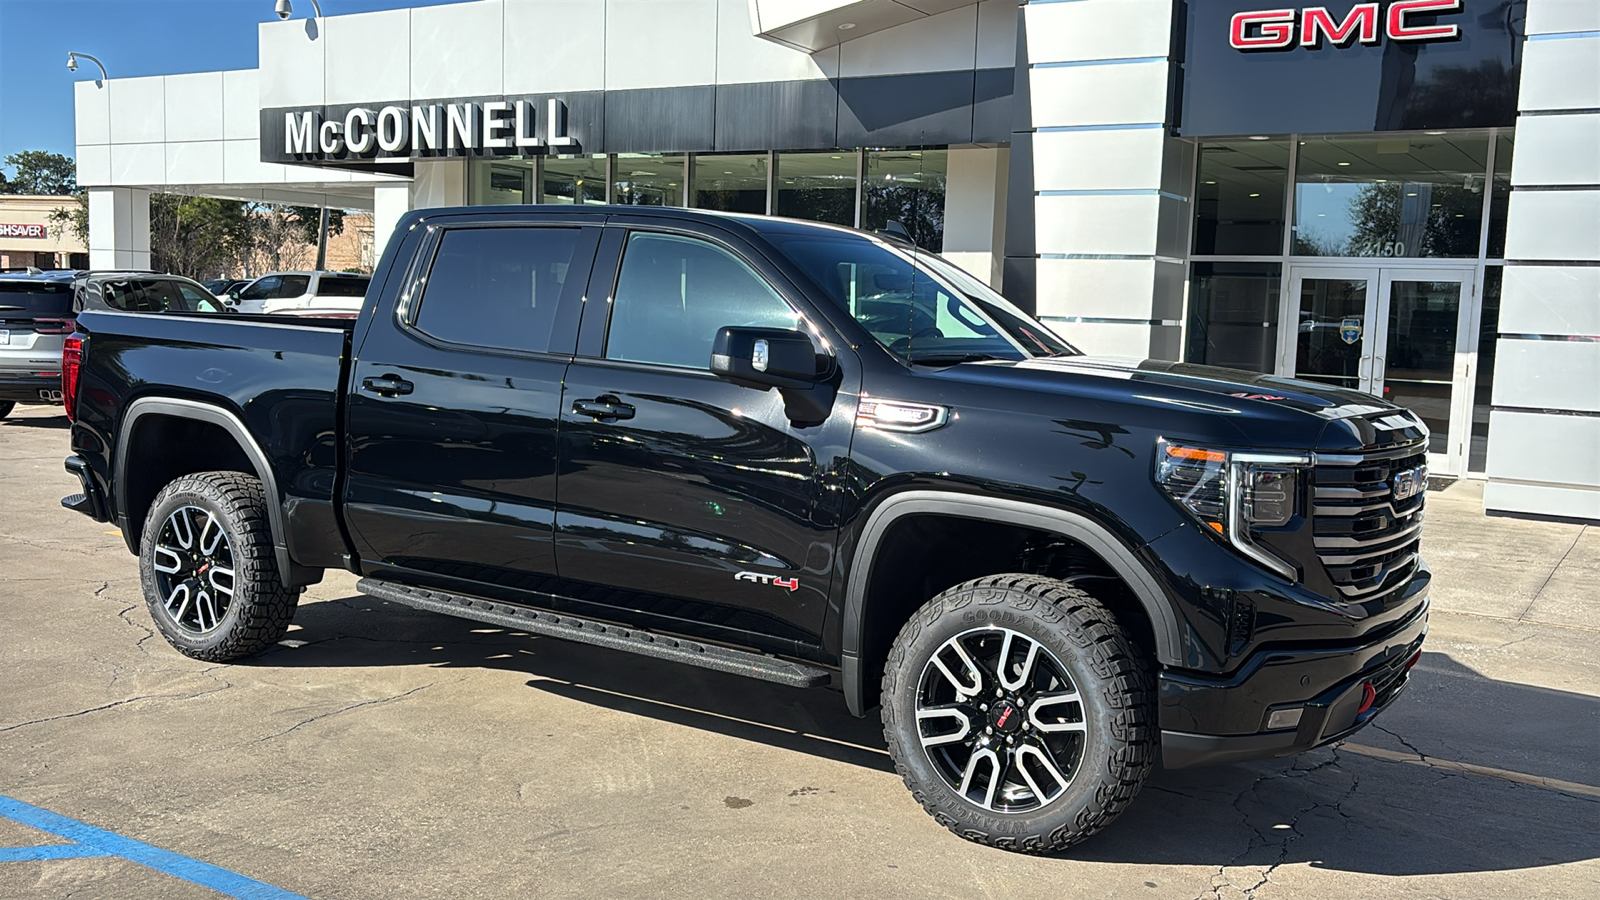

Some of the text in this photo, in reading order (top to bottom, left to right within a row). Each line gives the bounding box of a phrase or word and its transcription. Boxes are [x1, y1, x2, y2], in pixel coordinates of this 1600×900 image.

[1229, 0, 1460, 49] GMC
[285, 98, 572, 154] McCONNELL
[734, 571, 799, 592] AT4
[962, 609, 1078, 663] GOODYEAR
[924, 779, 1029, 834] WRANGLER
